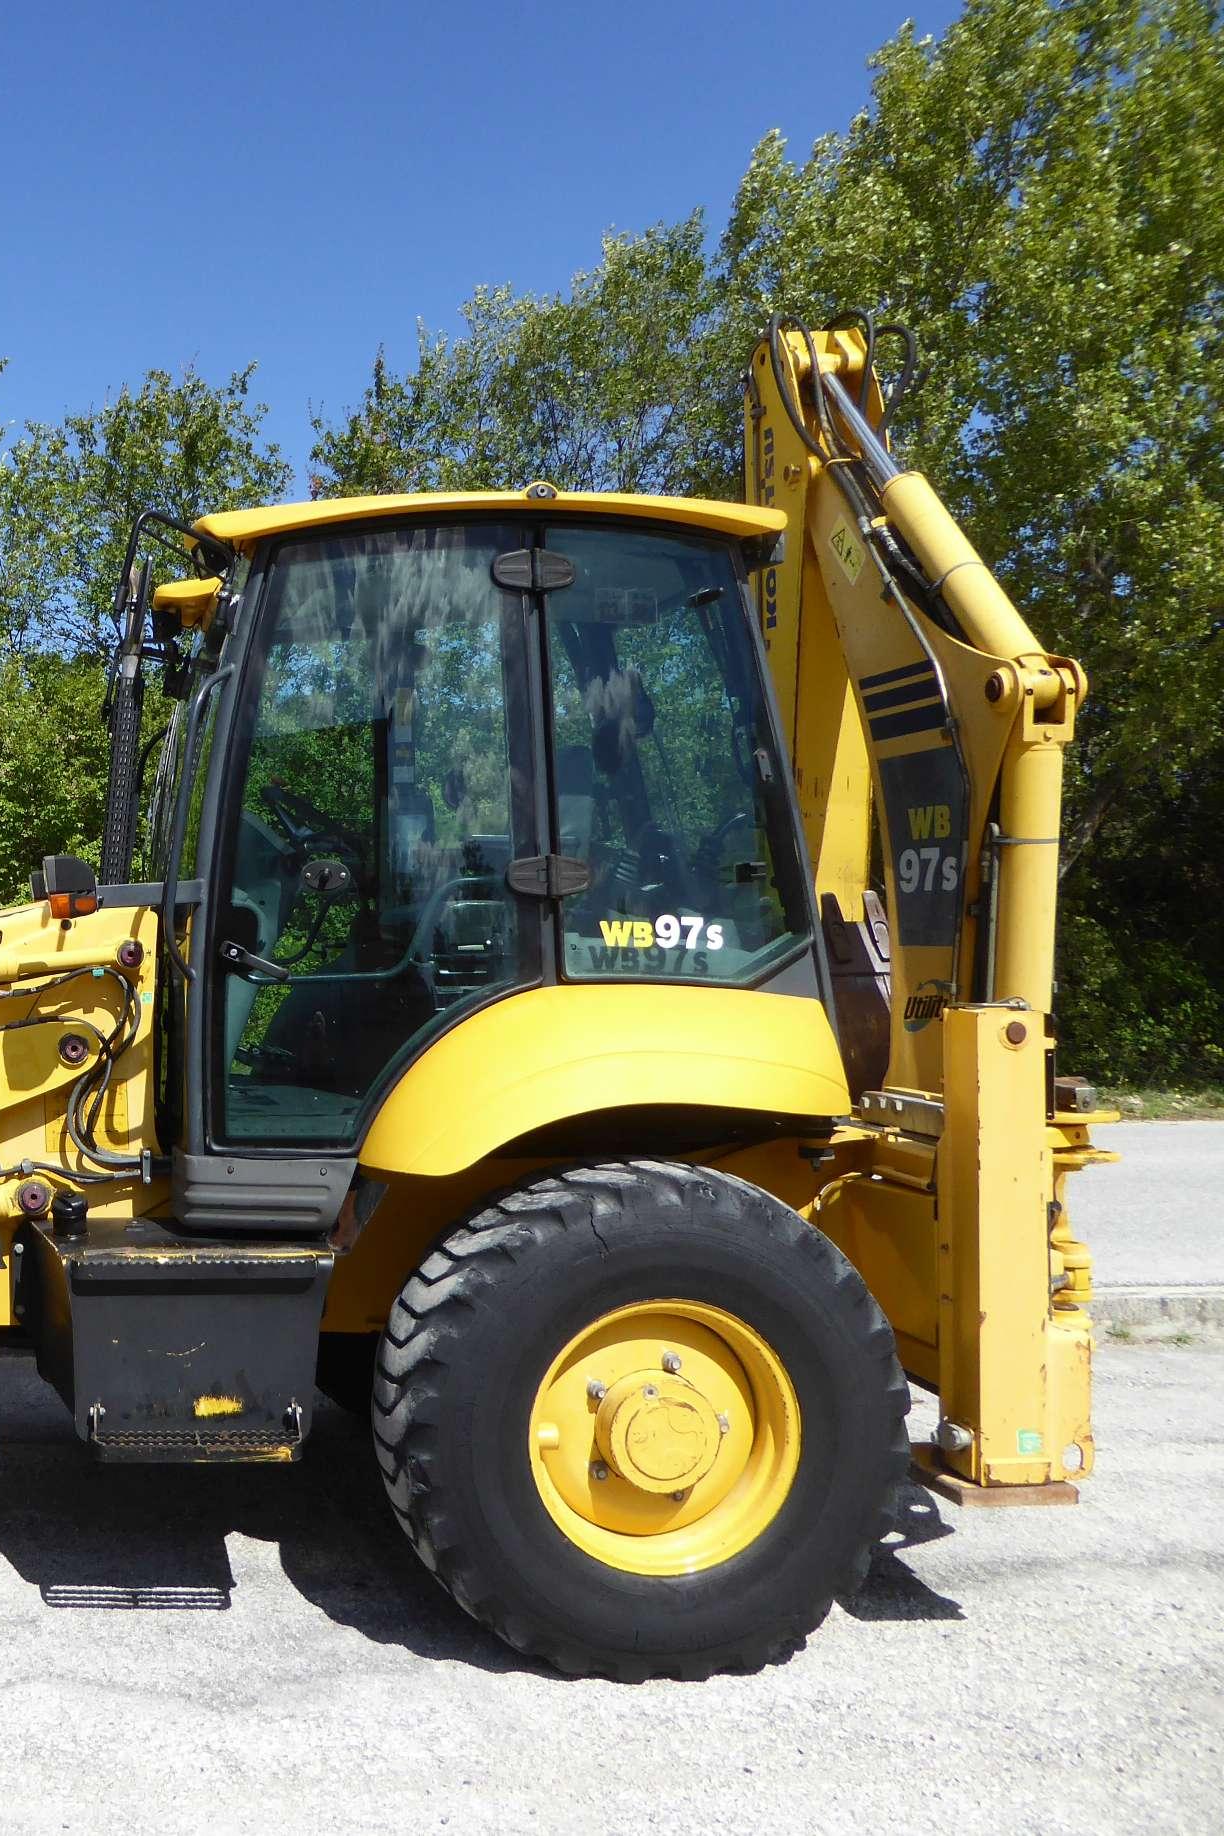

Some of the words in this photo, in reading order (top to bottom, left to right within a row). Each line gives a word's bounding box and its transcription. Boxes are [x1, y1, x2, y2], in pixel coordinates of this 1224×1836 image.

[762, 427, 777, 629] KOTSU
[908, 805, 951, 840] WB
[899, 847, 958, 893] 97s
